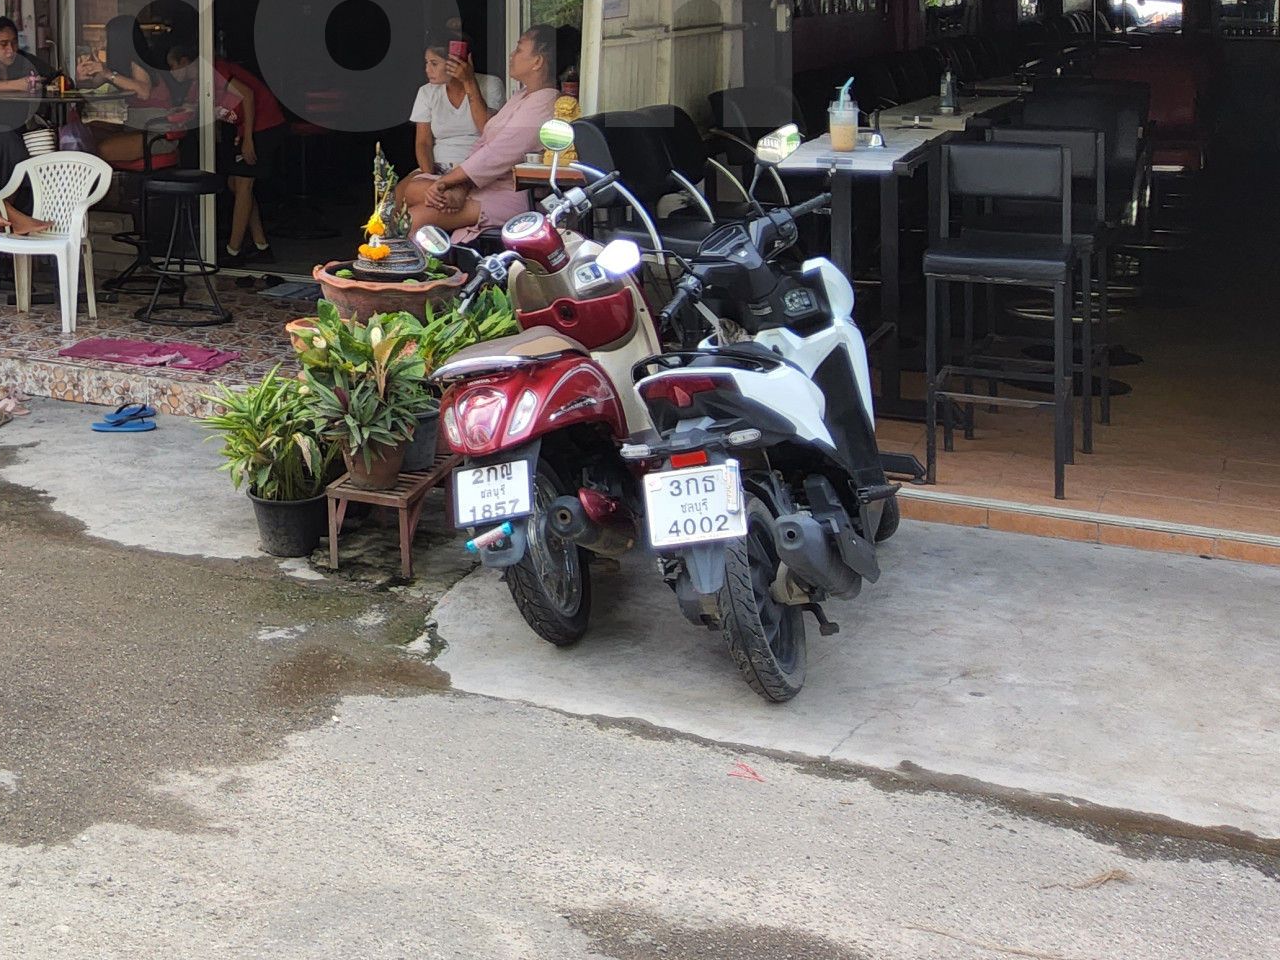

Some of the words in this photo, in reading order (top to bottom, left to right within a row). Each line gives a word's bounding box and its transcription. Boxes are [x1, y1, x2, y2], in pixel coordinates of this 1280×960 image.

[669, 475, 716, 497] 3กธ
[469, 498, 520, 521] 1857
[680, 498, 709, 515] ชลบุรี
[668, 514, 729, 537] 4002
